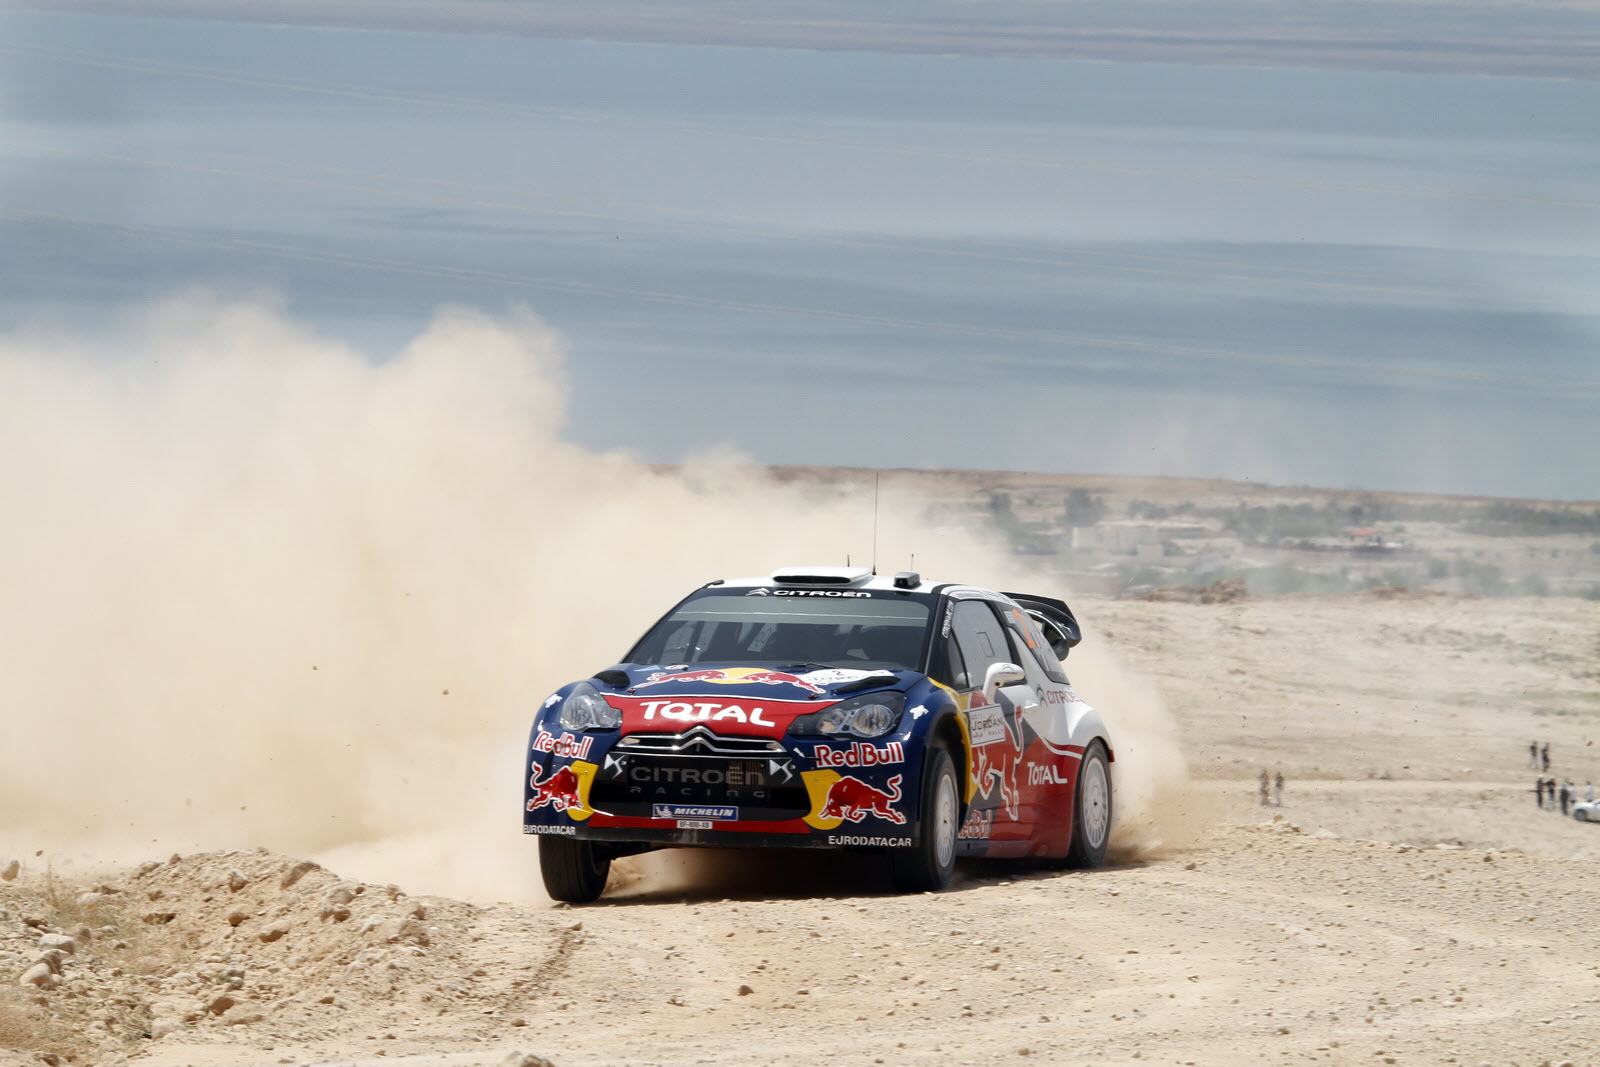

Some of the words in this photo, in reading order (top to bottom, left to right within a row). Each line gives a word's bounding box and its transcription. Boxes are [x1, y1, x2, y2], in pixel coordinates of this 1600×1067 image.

[640, 701, 775, 727] TOTAL
[972, 717, 1003, 731] JORDAN
[1027, 762, 1068, 786] TOTAL
[674, 807, 733, 817] MICHELIN
[523, 825, 576, 835] EURODATACAR
